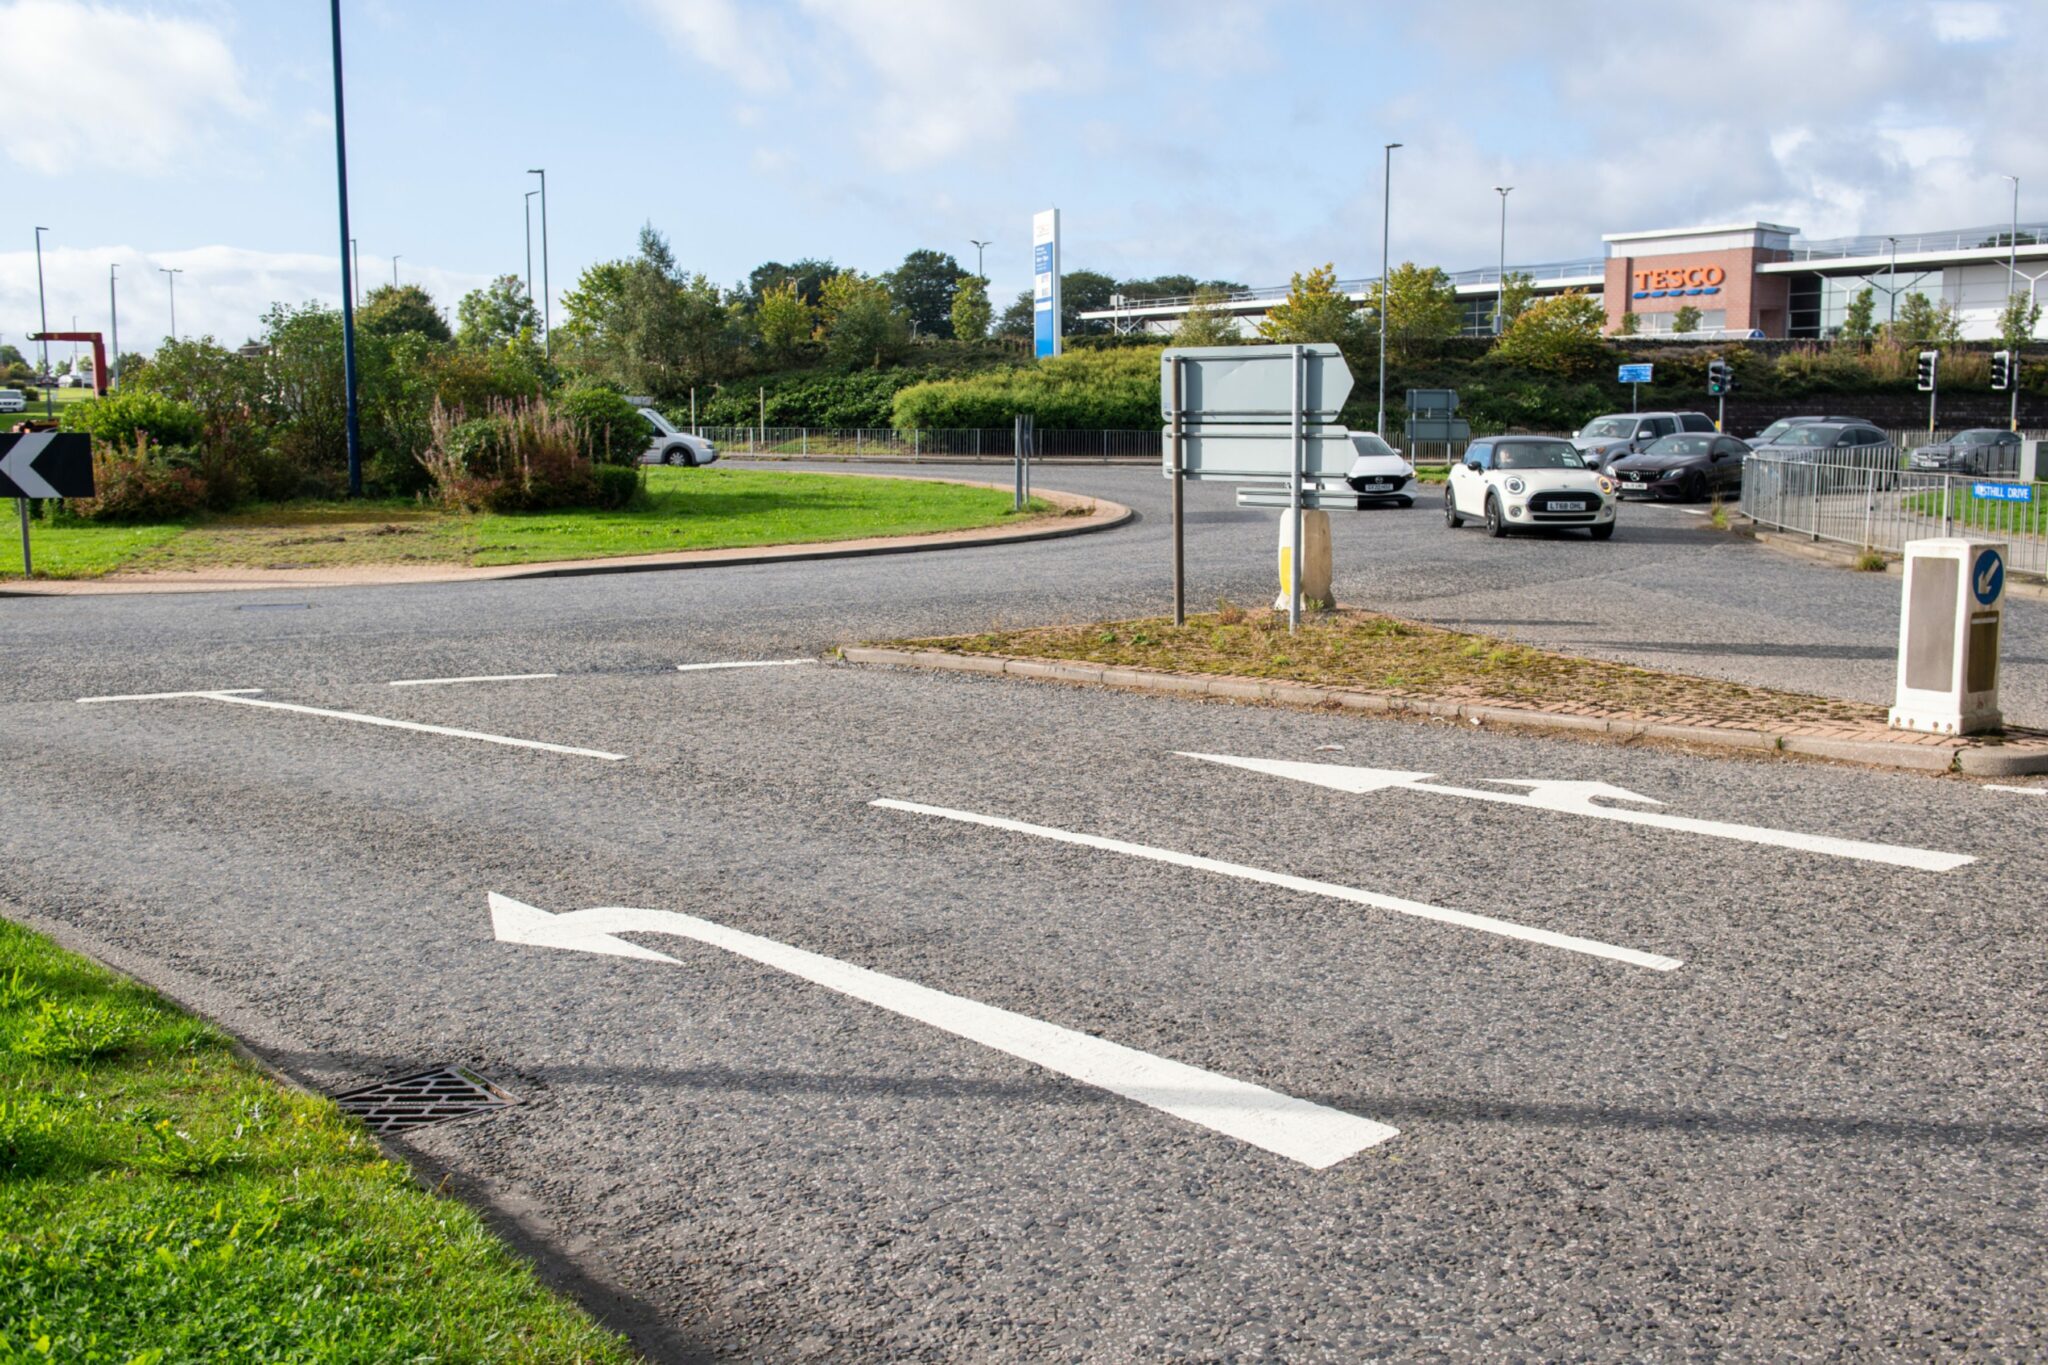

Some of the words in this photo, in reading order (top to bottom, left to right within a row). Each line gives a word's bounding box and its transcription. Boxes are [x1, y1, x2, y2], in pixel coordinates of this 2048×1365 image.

[1633, 263, 1725, 290] TESCO
[1974, 485, 2004, 498] WSTHILL
[2007, 487, 2030, 499] DRIVE
